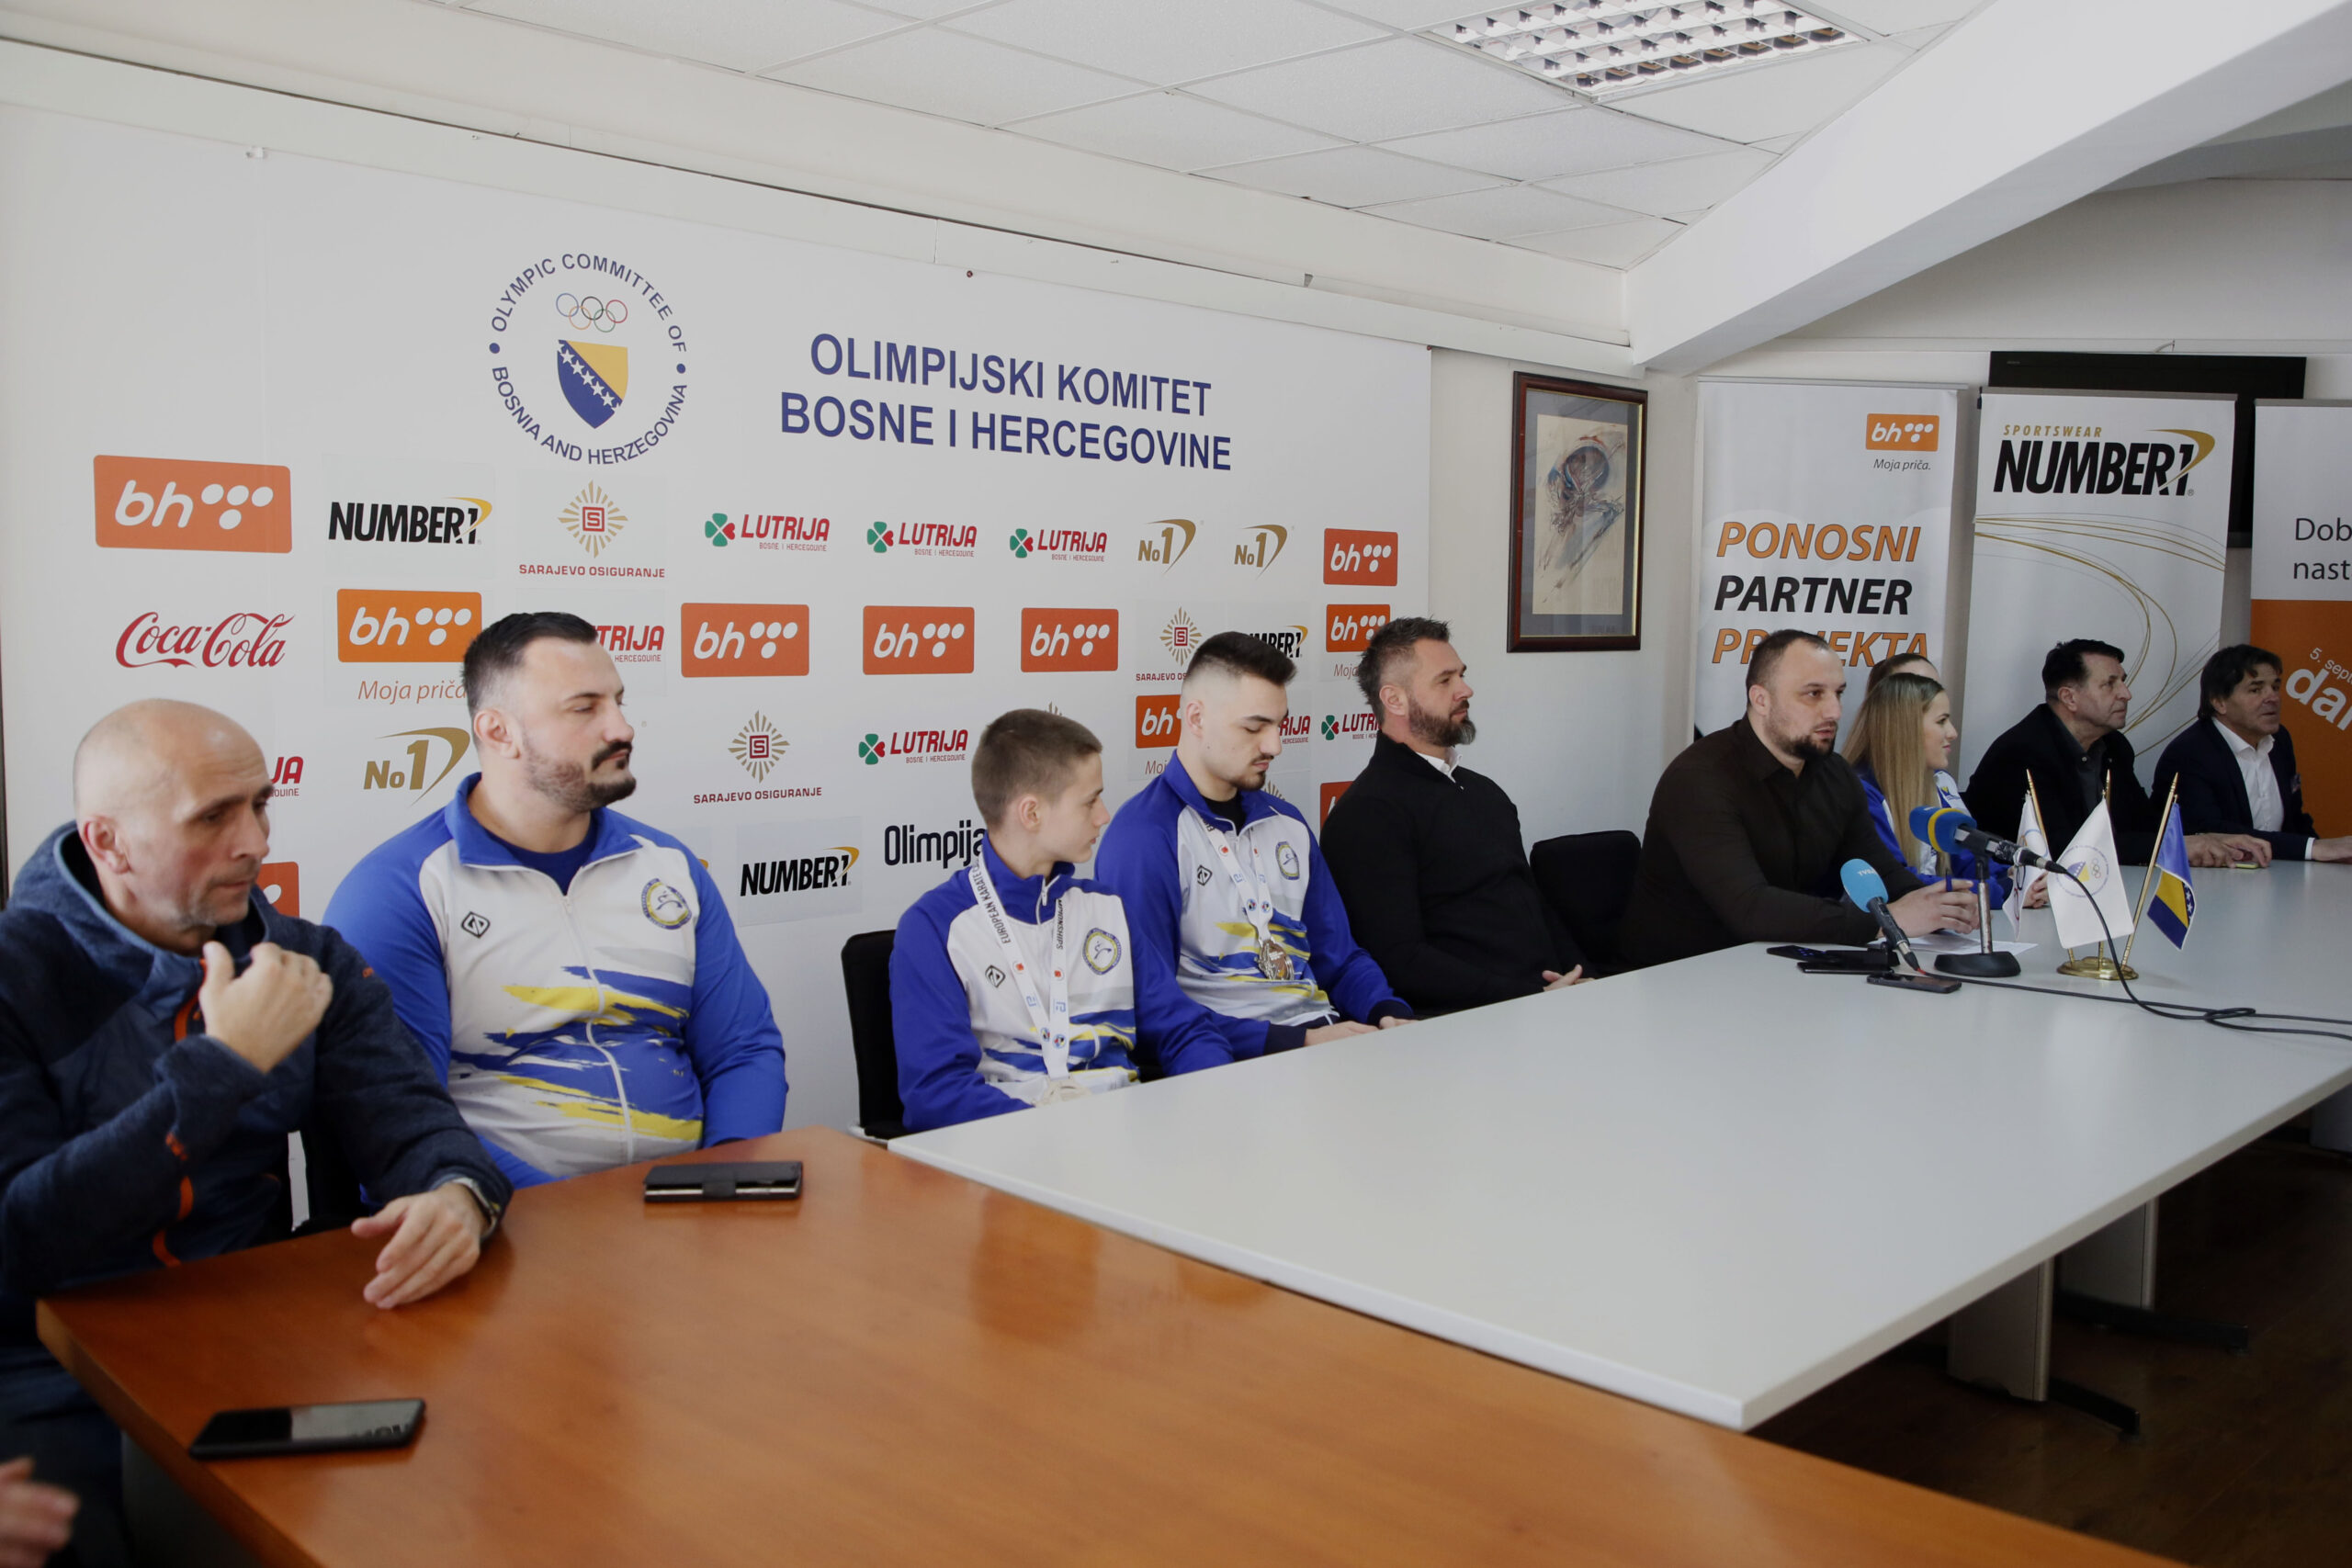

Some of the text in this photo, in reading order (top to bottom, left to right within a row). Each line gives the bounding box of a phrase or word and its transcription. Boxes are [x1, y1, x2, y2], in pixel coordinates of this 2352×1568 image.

[492, 254, 686, 353] OLYMPIC COMMITTEE OF
[810, 333, 1212, 416] OLIMPIJSKI KOMITET
[492, 367, 687, 465] BOSNIA AND HERZEGOVINA
[780, 391, 1231, 470] BOSNE I HERCEGOVINE
[2003, 424, 2103, 438] SPORTSWEAR
[1873, 458, 1931, 471] Moja priča.
[1993, 440, 2194, 496] NUMBER1
[328, 502, 479, 544] NUMBER1
[741, 514, 830, 541] LUTRIJA
[899, 523, 977, 547] LUTRIJA
[1037, 529, 1107, 552] LUTRIJA
[1716, 521, 1921, 562] PONOSNI
[519, 564, 665, 578] SARAJEVO OSIGURANJE
[1714, 575, 1913, 615] PARTNER
[115, 611, 295, 669] Coca-Cola
[2310, 648, 2323, 662] 5.
[358, 680, 411, 705] Moja
[1136, 672, 1176, 681] SARAJEVO
[889, 729, 968, 754] LUTRIJA
[694, 787, 822, 804] SARAJEVO OSIGURANJE
[740, 854, 849, 897] NUMBER1
[973, 872, 1012, 944] EUROPEAN KARATE
